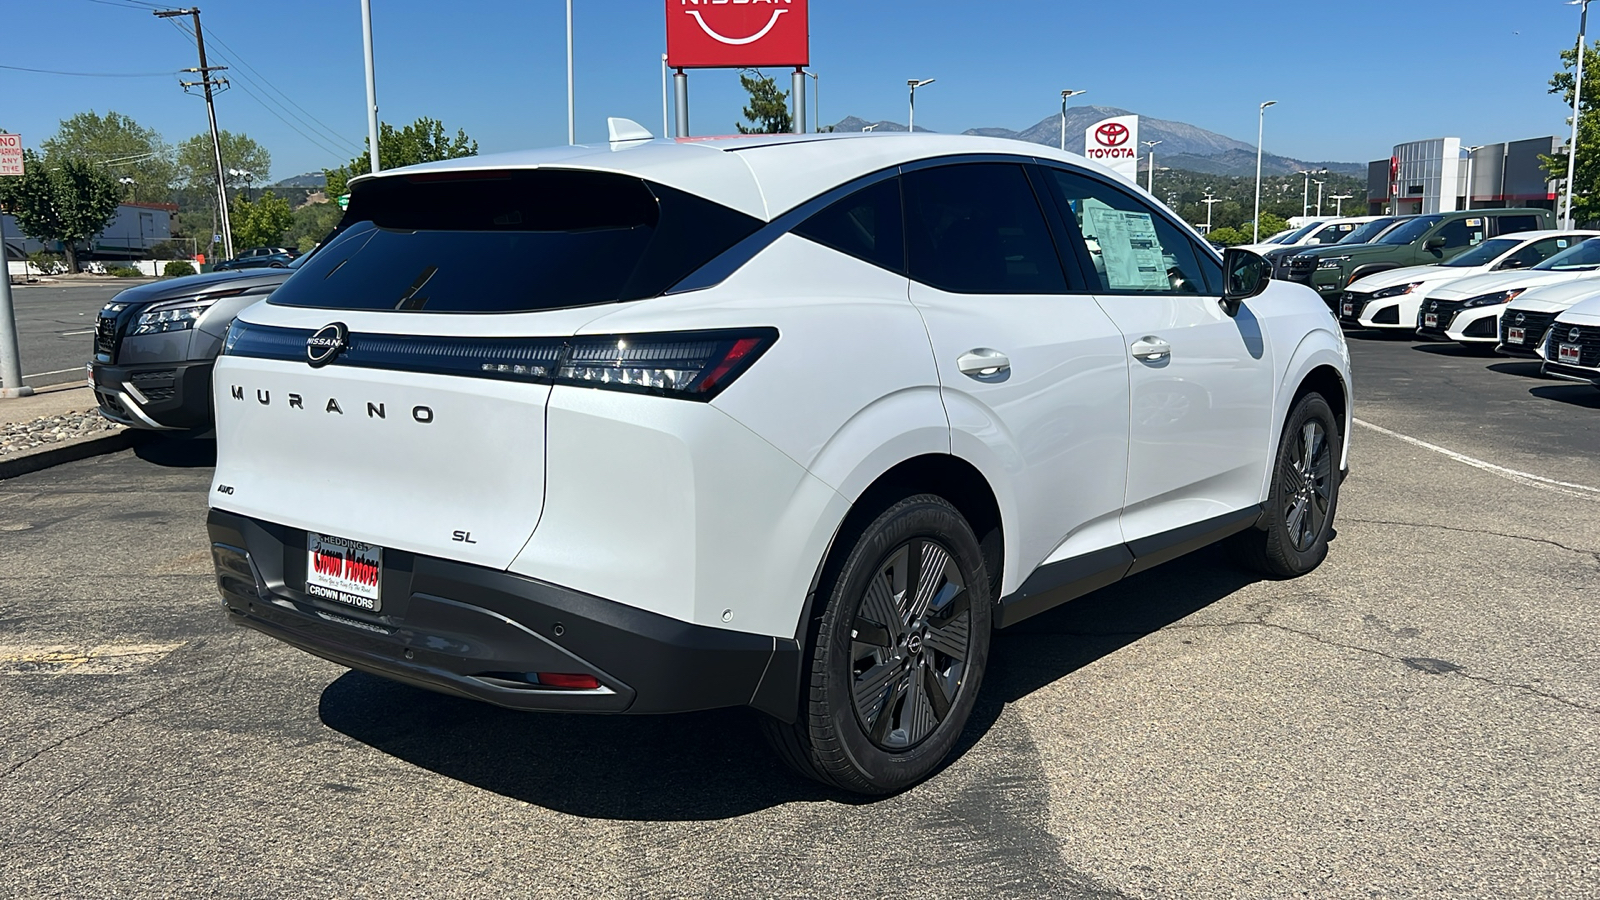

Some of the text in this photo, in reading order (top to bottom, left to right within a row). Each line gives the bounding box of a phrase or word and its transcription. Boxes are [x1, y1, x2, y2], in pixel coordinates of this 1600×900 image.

[0, 138, 15, 147] NO
[1088, 148, 1135, 159] TOYOTA
[306, 337, 340, 346] NISSAN
[231, 384, 434, 424] MURANO
[452, 530, 477, 544] SL
[310, 585, 373, 609] CROWN MOTORS
